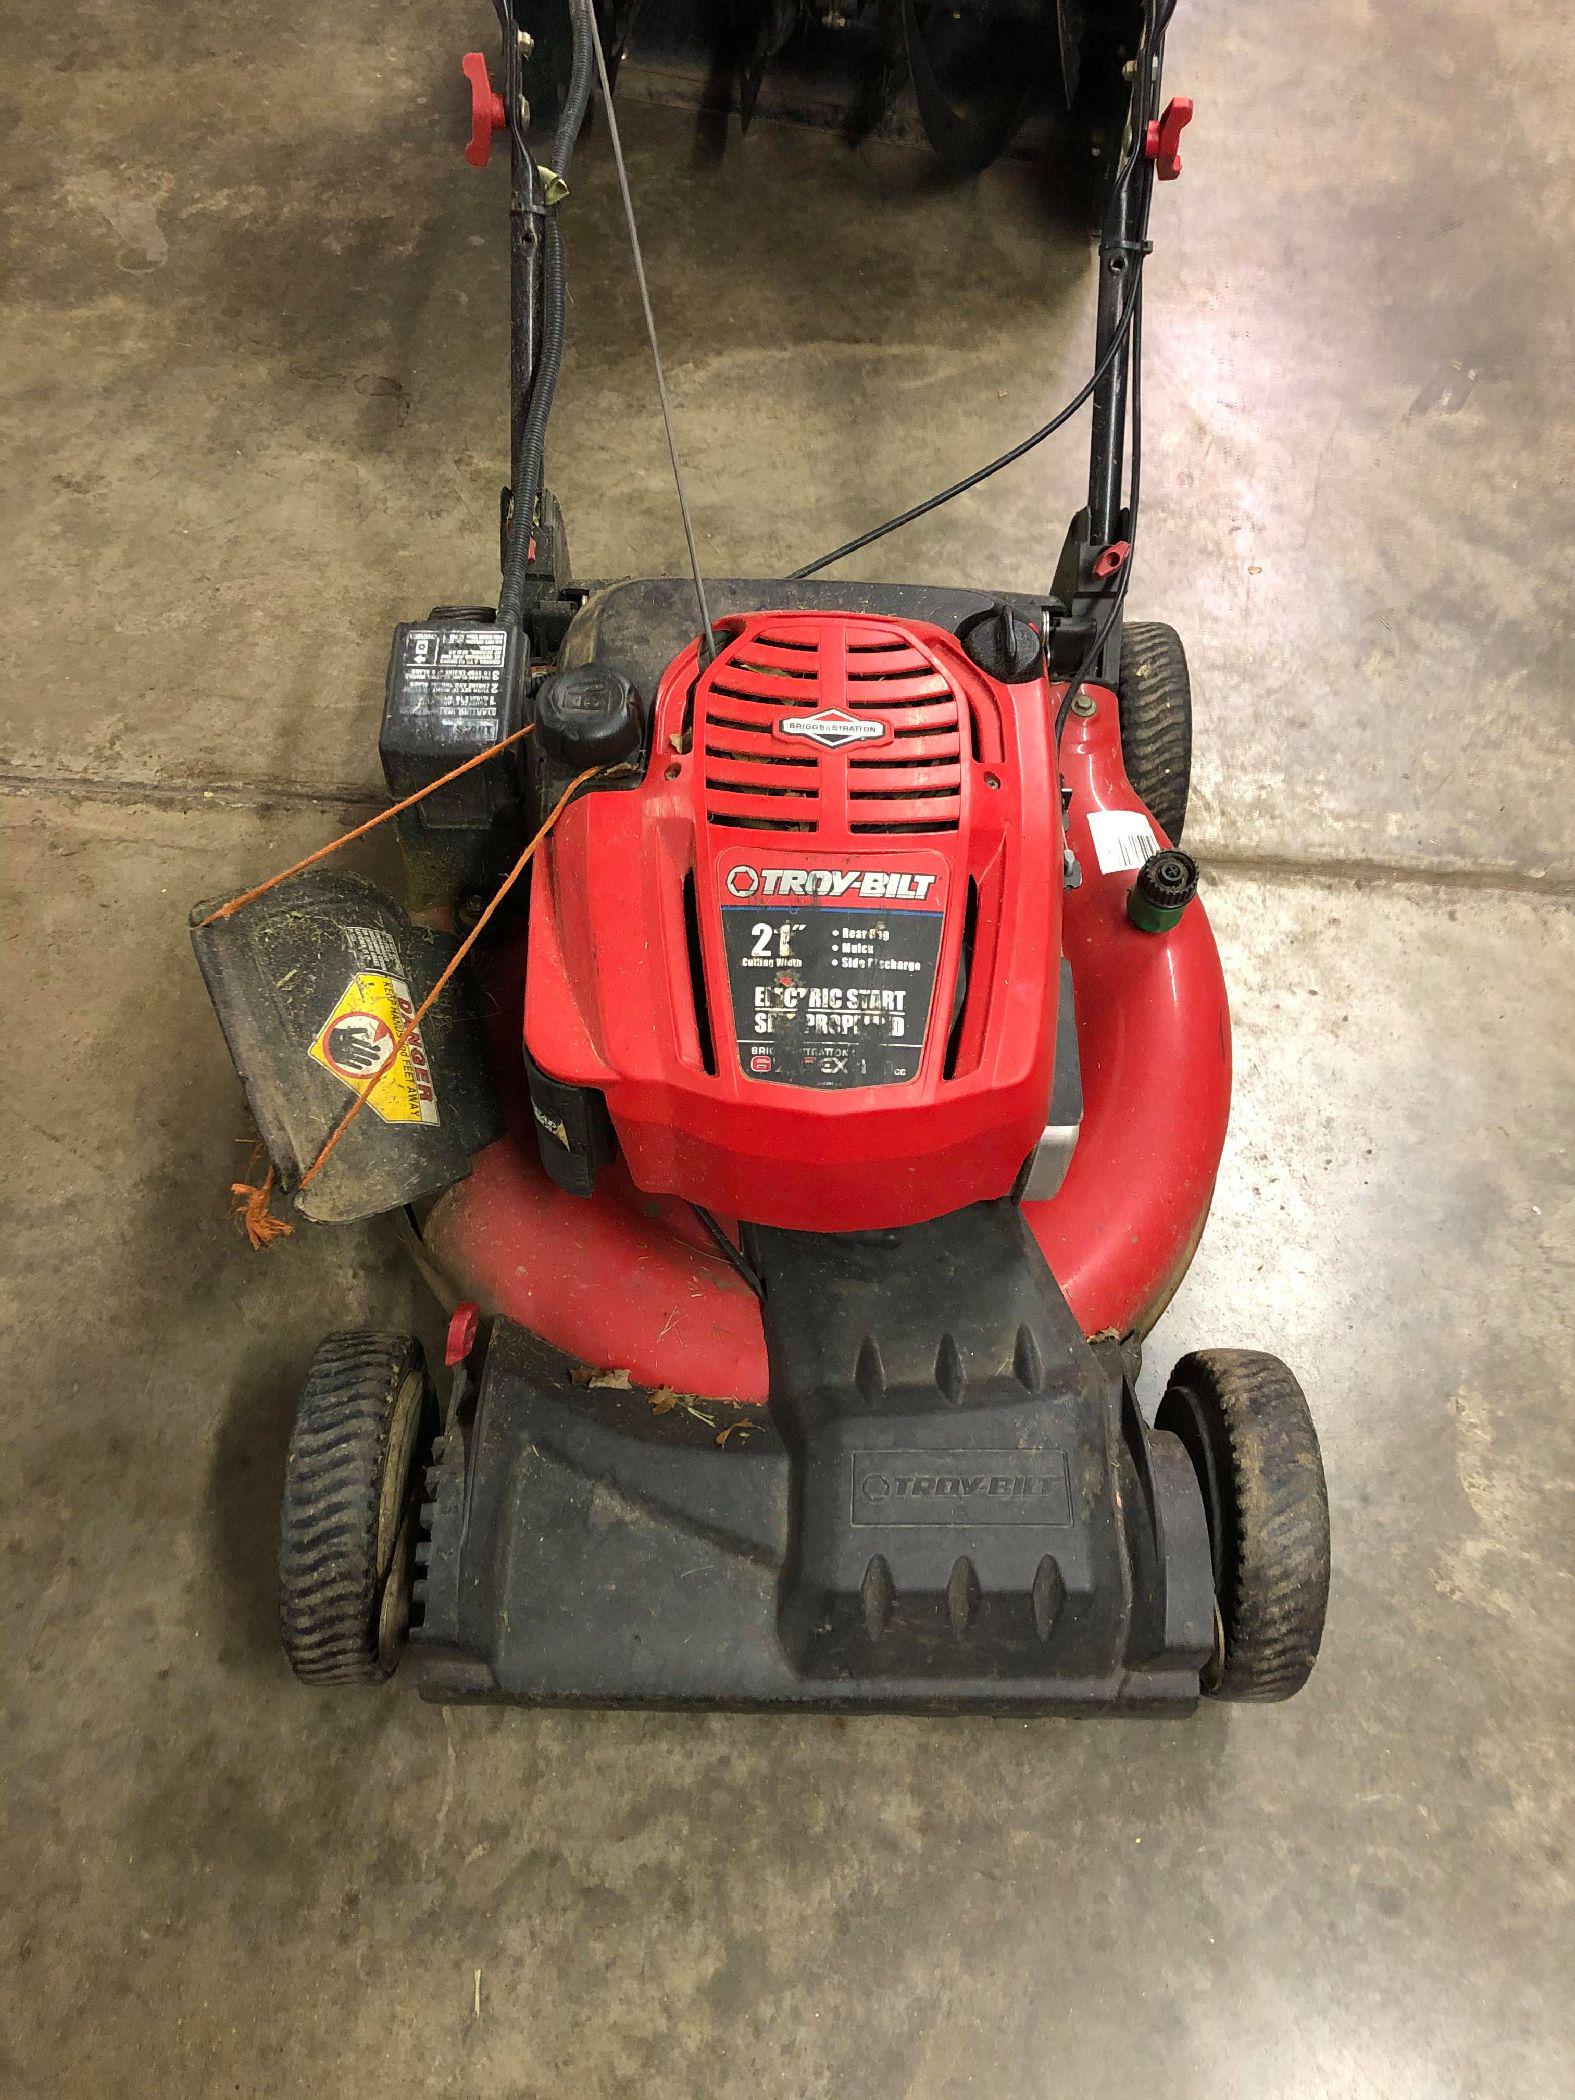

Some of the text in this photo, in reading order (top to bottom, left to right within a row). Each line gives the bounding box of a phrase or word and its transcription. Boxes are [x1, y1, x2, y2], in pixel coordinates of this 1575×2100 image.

[761, 869, 936, 900] TROY-BILT
[842, 928, 867, 939] Rear
[842, 957, 921, 972] Side scharge
[846, 989, 907, 1011] START
[399, 997, 433, 1101] DANGER
[390, 1006, 404, 1038] HANDS
[407, 1086, 421, 1117] AWAY
[893, 1475, 1061, 1497] TROY-BILT
